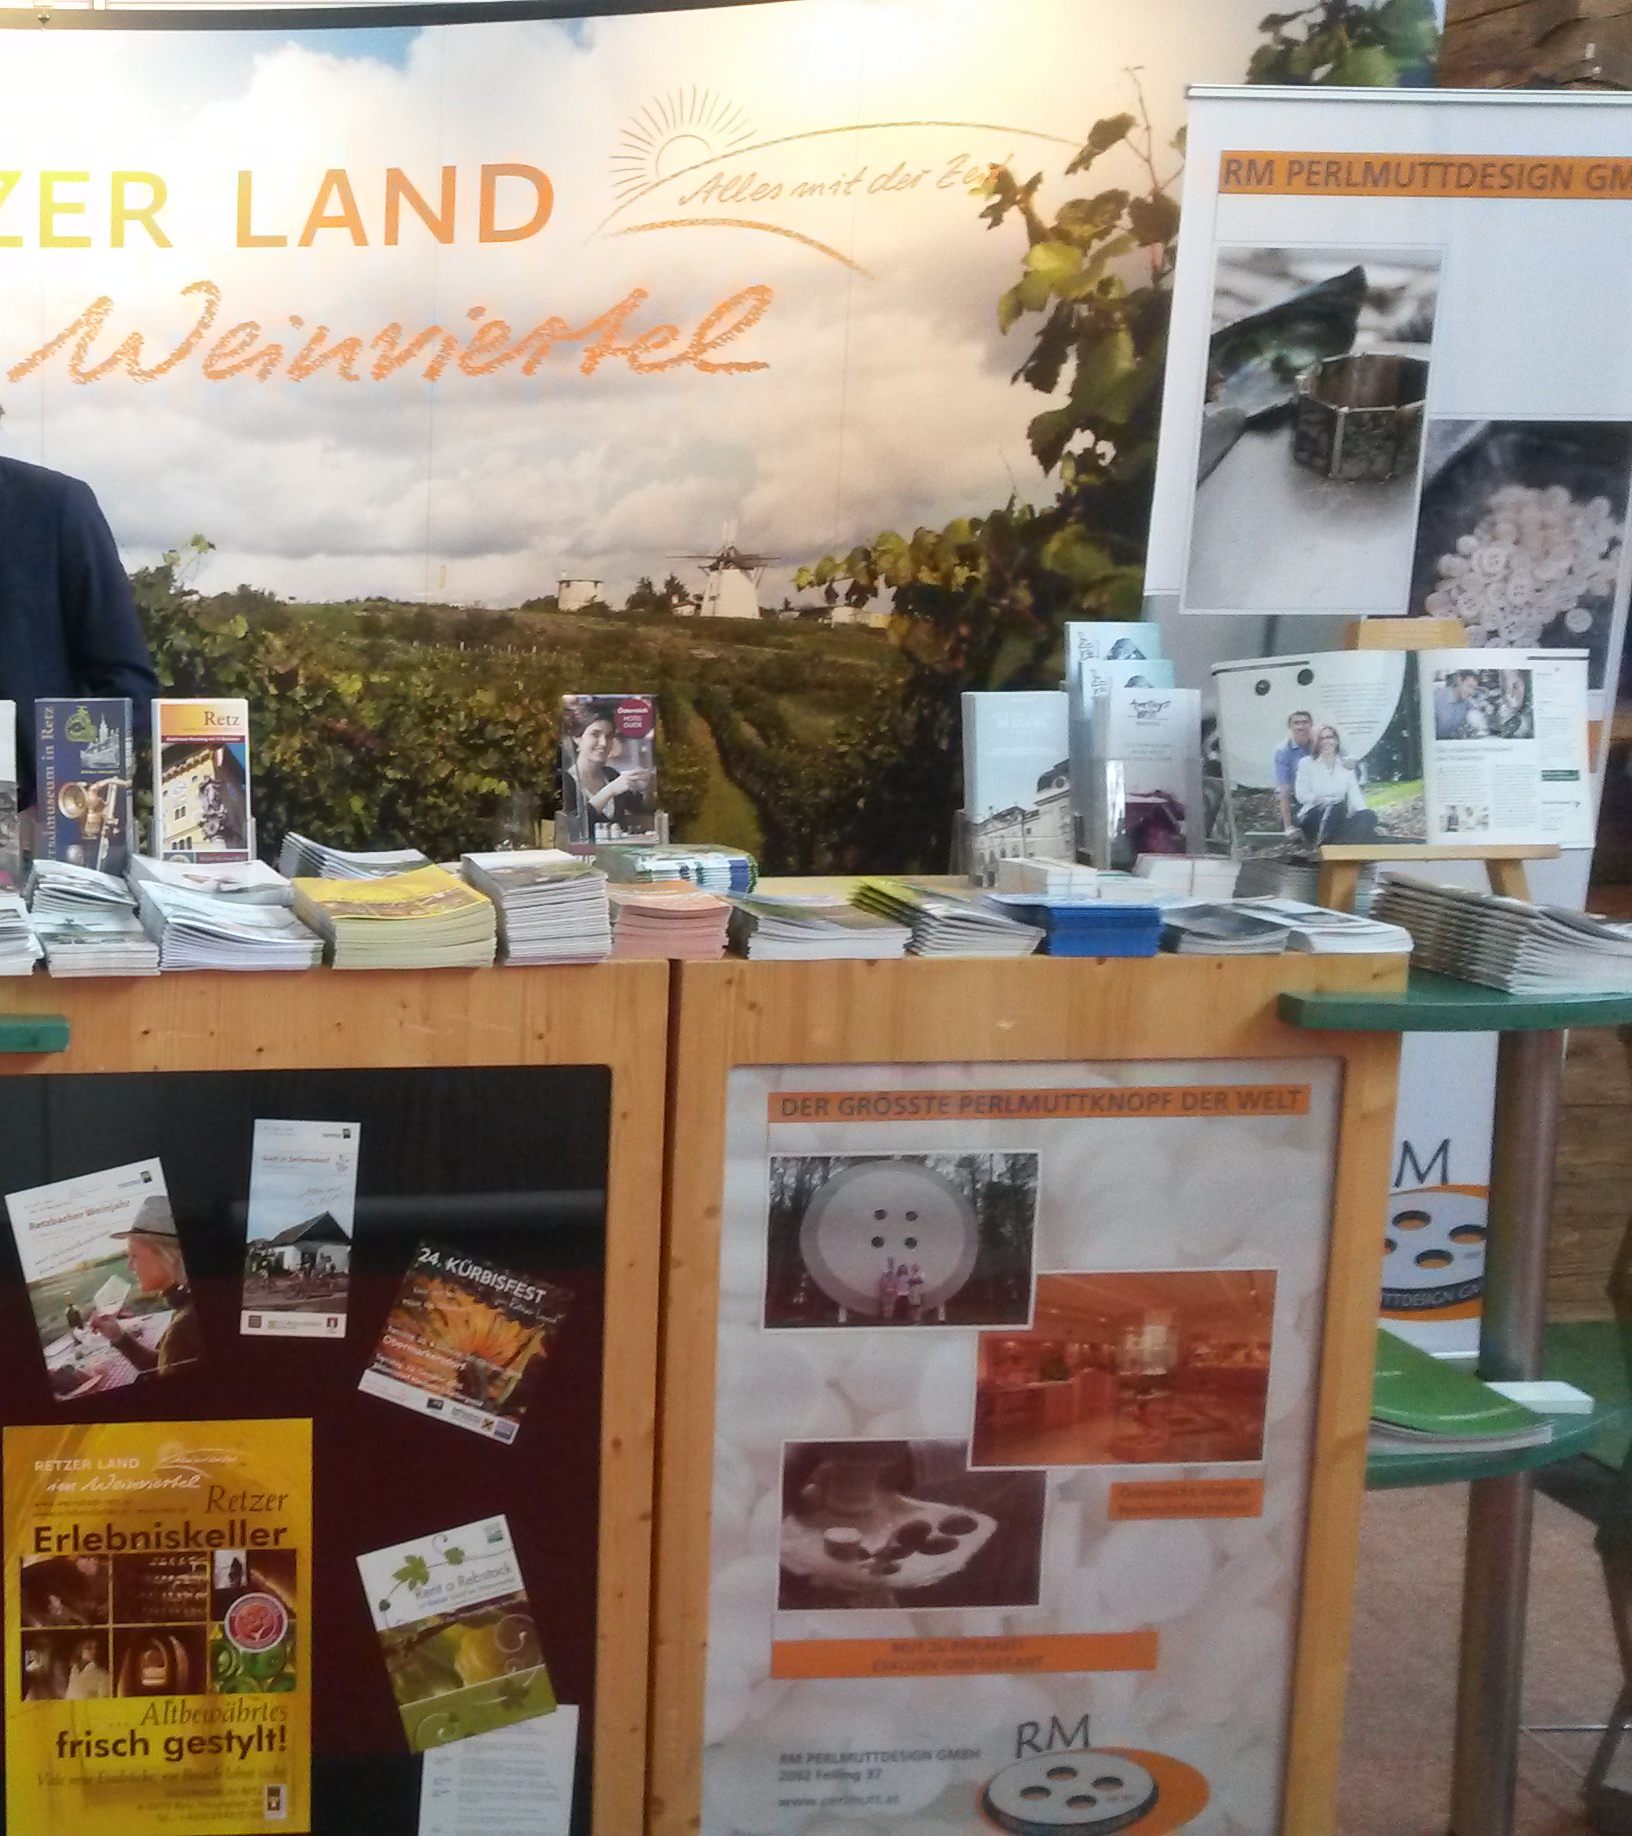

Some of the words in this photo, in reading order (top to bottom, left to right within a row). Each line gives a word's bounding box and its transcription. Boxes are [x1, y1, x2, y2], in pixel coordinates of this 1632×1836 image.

[678, 171, 784, 206] Alles
[790, 166, 868, 198] mit
[868, 161, 932, 195] der
[935, 152, 1014, 191] Ze
[1223, 158, 1276, 186] RM
[1286, 160, 1574, 191] PERLMUTTDESIGN
[236, 162, 556, 248] LAND
[6, 280, 774, 384] Weinviertel
[40, 705, 56, 741] Retz
[203, 710, 241, 727] Retz
[781, 1096, 830, 1117] DER
[838, 1091, 951, 1116] GRÖSSTE
[959, 1092, 1175, 1115] PERLMUTTKNOPF
[1180, 1091, 1229, 1113] DER
[1237, 1089, 1304, 1111] WELT
[1394, 1137, 1451, 1188] M
[418, 1246, 442, 1269] 24.
[444, 1257, 548, 1305] KÜRBISFEST
[1382, 1288, 1455, 1308] TTDESIGN
[34, 1458, 92, 1472] RETZER
[97, 1457, 140, 1470] LAND
[205, 1484, 290, 1514] Retzer
[33, 1519, 288, 1554] Erlebniskeller
[140, 1697, 289, 1726] Altbewährtes
[55, 1728, 150, 1759] frisch
[163, 1724, 288, 1763] gestylt!
[1015, 1712, 1091, 1760] RM
